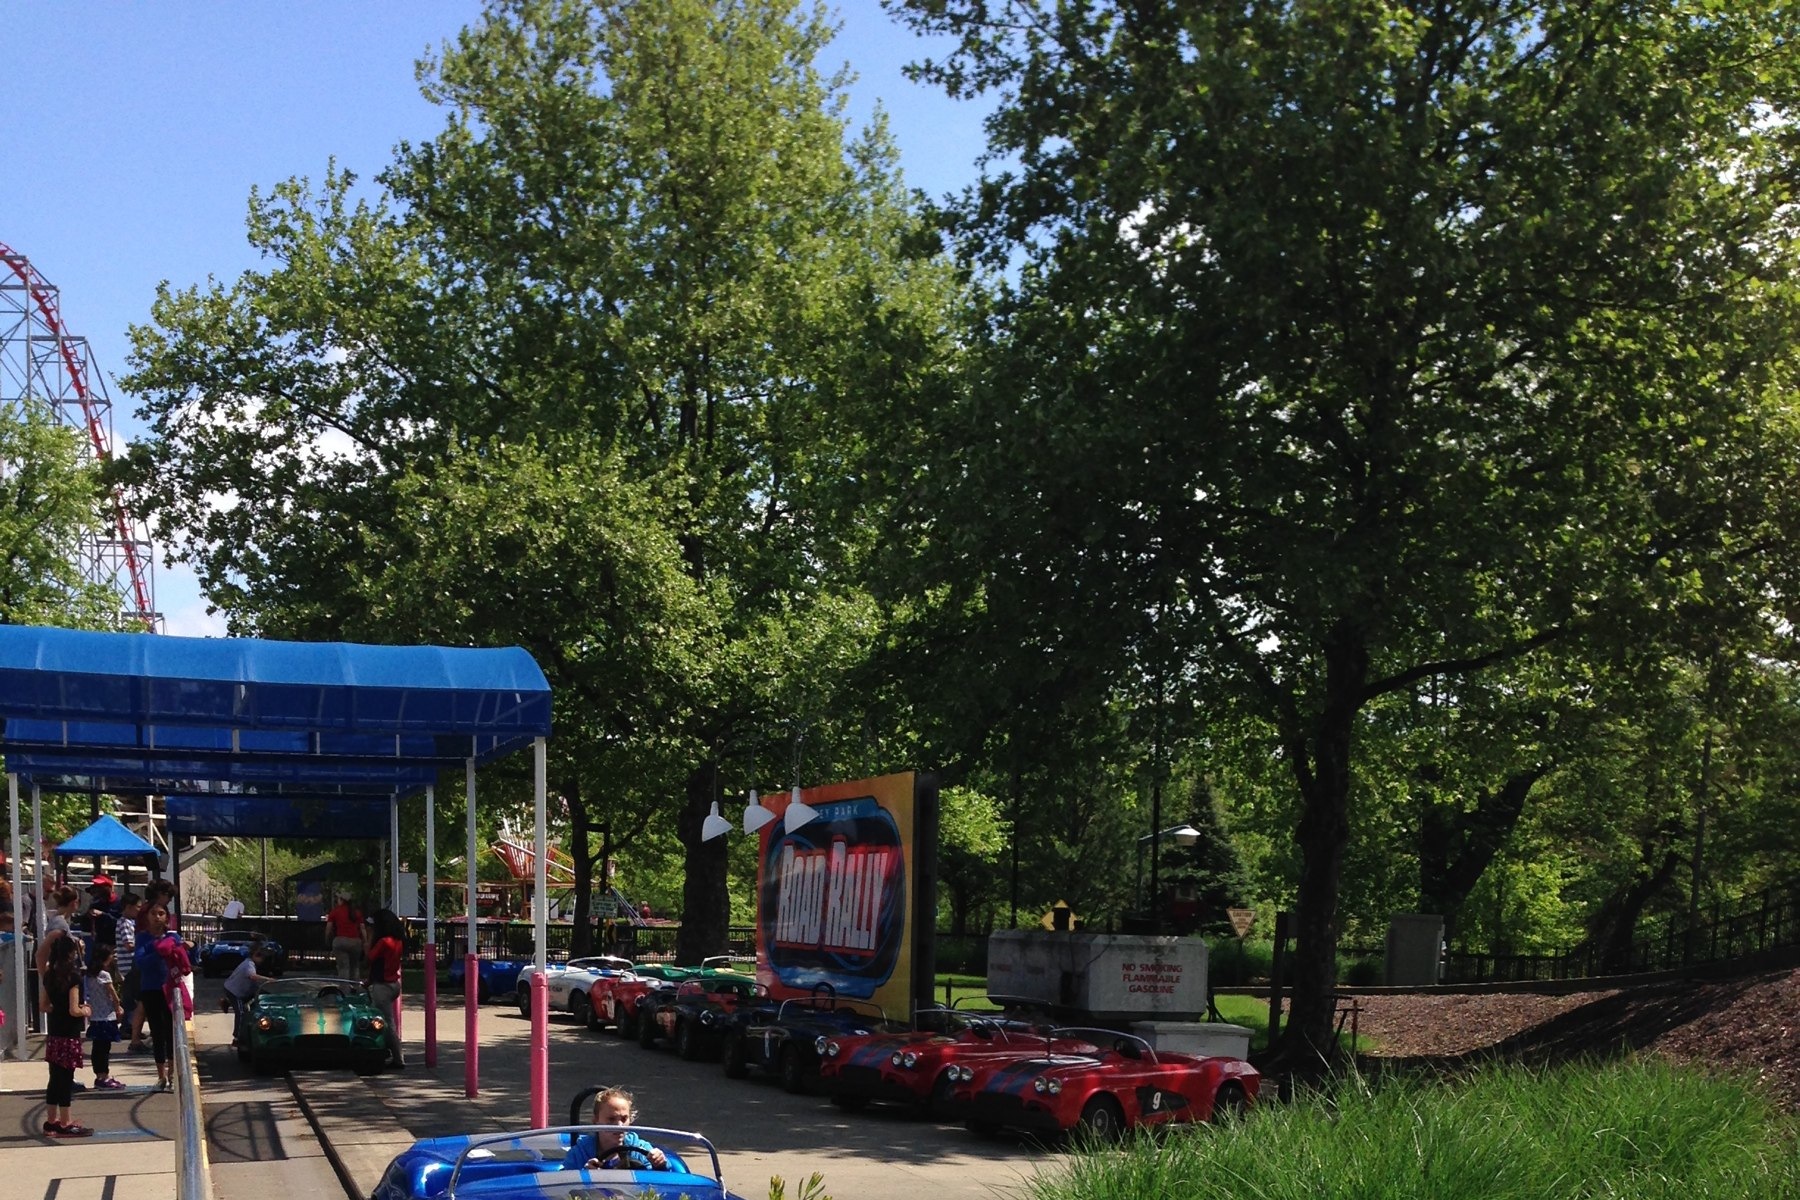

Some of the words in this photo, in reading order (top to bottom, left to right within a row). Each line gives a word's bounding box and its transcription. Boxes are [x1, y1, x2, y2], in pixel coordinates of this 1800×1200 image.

[834, 805, 858, 816] PARK
[776, 845, 826, 944] ROAD
[825, 841, 888, 950] RALLY
[1122, 963, 1136, 972] NO
[1140, 963, 1183, 973] SMOKING
[1123, 974, 1181, 984] FLAMMABLE
[1129, 985, 1175, 994] GASOLINE
[1152, 1091, 1161, 1110] 9
